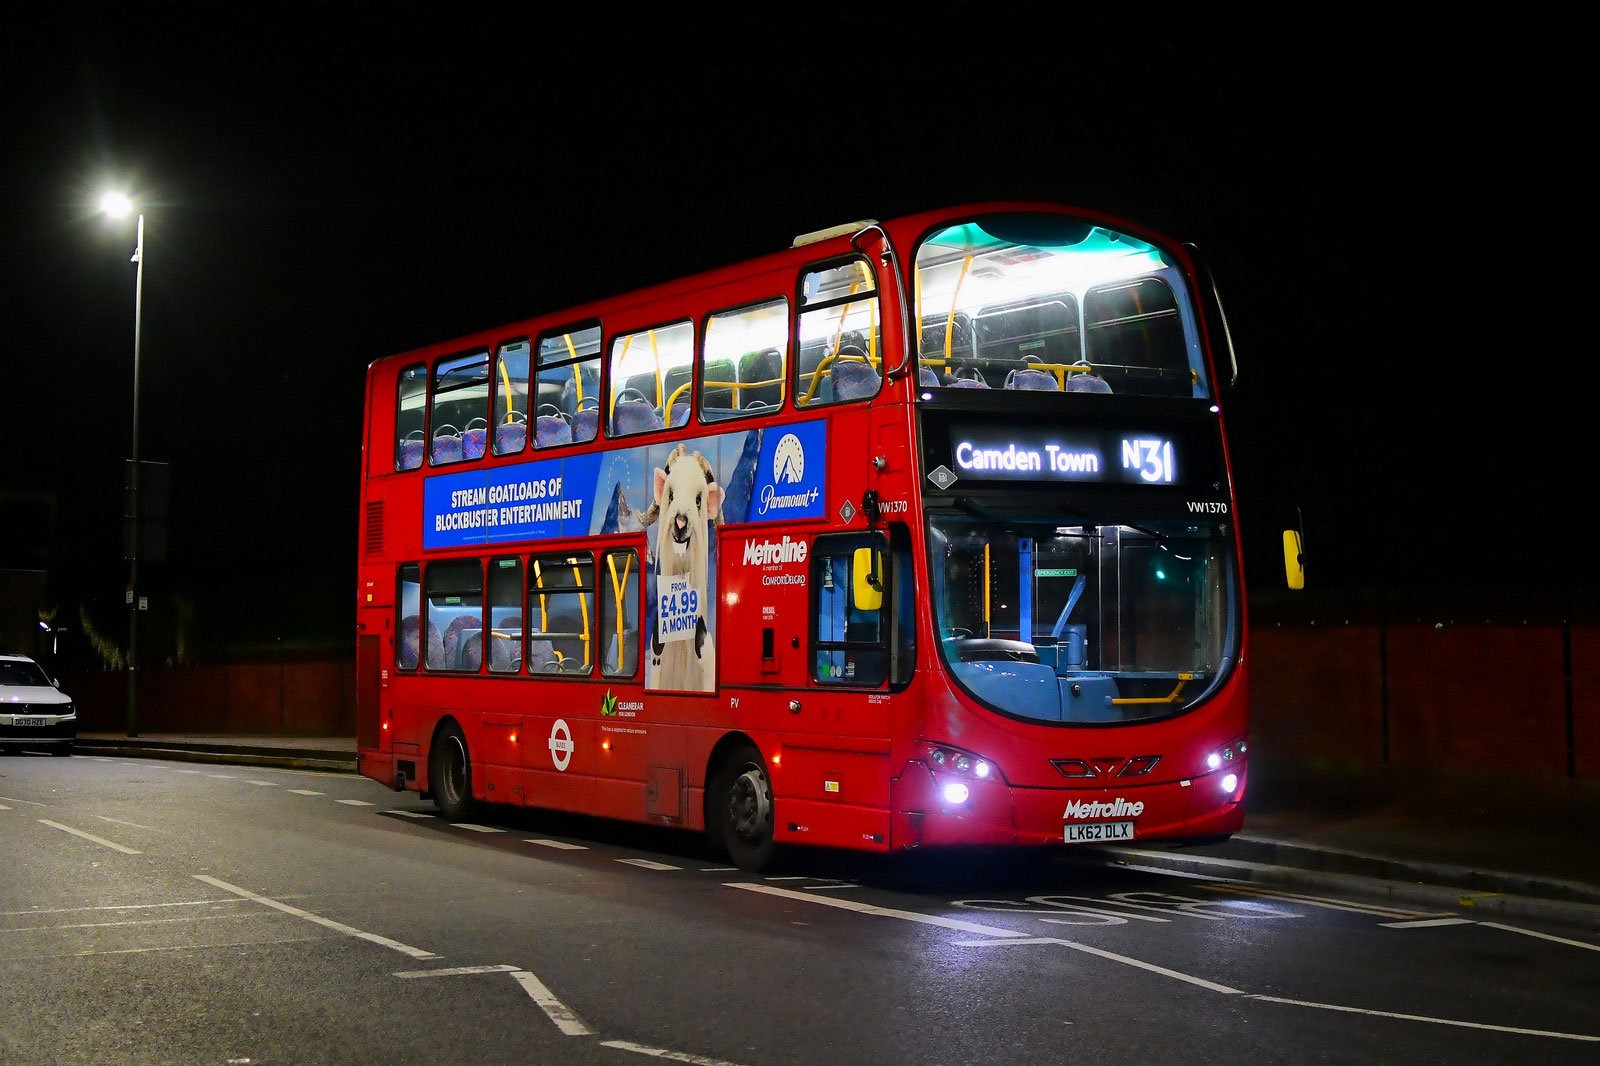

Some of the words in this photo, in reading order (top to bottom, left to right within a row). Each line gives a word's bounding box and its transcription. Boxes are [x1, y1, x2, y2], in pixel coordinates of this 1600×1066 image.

[956, 442, 1041, 471] Camden
[1045, 445, 1098, 472] Town
[1121, 439, 1173, 482] N31
[451, 487, 487, 508] STREAM
[488, 479, 547, 503] GOATLOADS
[548, 477, 562, 498] OF
[435, 508, 498, 532] BLOCKBUSTER
[500, 499, 582, 526] ENTERTAINMENT
[878, 500, 908, 514] VW1370
[1187, 501, 1228, 514] VW1370
[742, 535, 808, 566] Metroline
[671, 581, 687, 592] FROM
[661, 590, 698, 618] £4.99
[661, 622, 669, 635] A
[669, 615, 698, 632] MONTH
[730, 698, 739, 709] PV
[1063, 797, 1145, 819] Metroline
[1069, 825, 1102, 841] LK62
[1105, 824, 1129, 839] DLX
